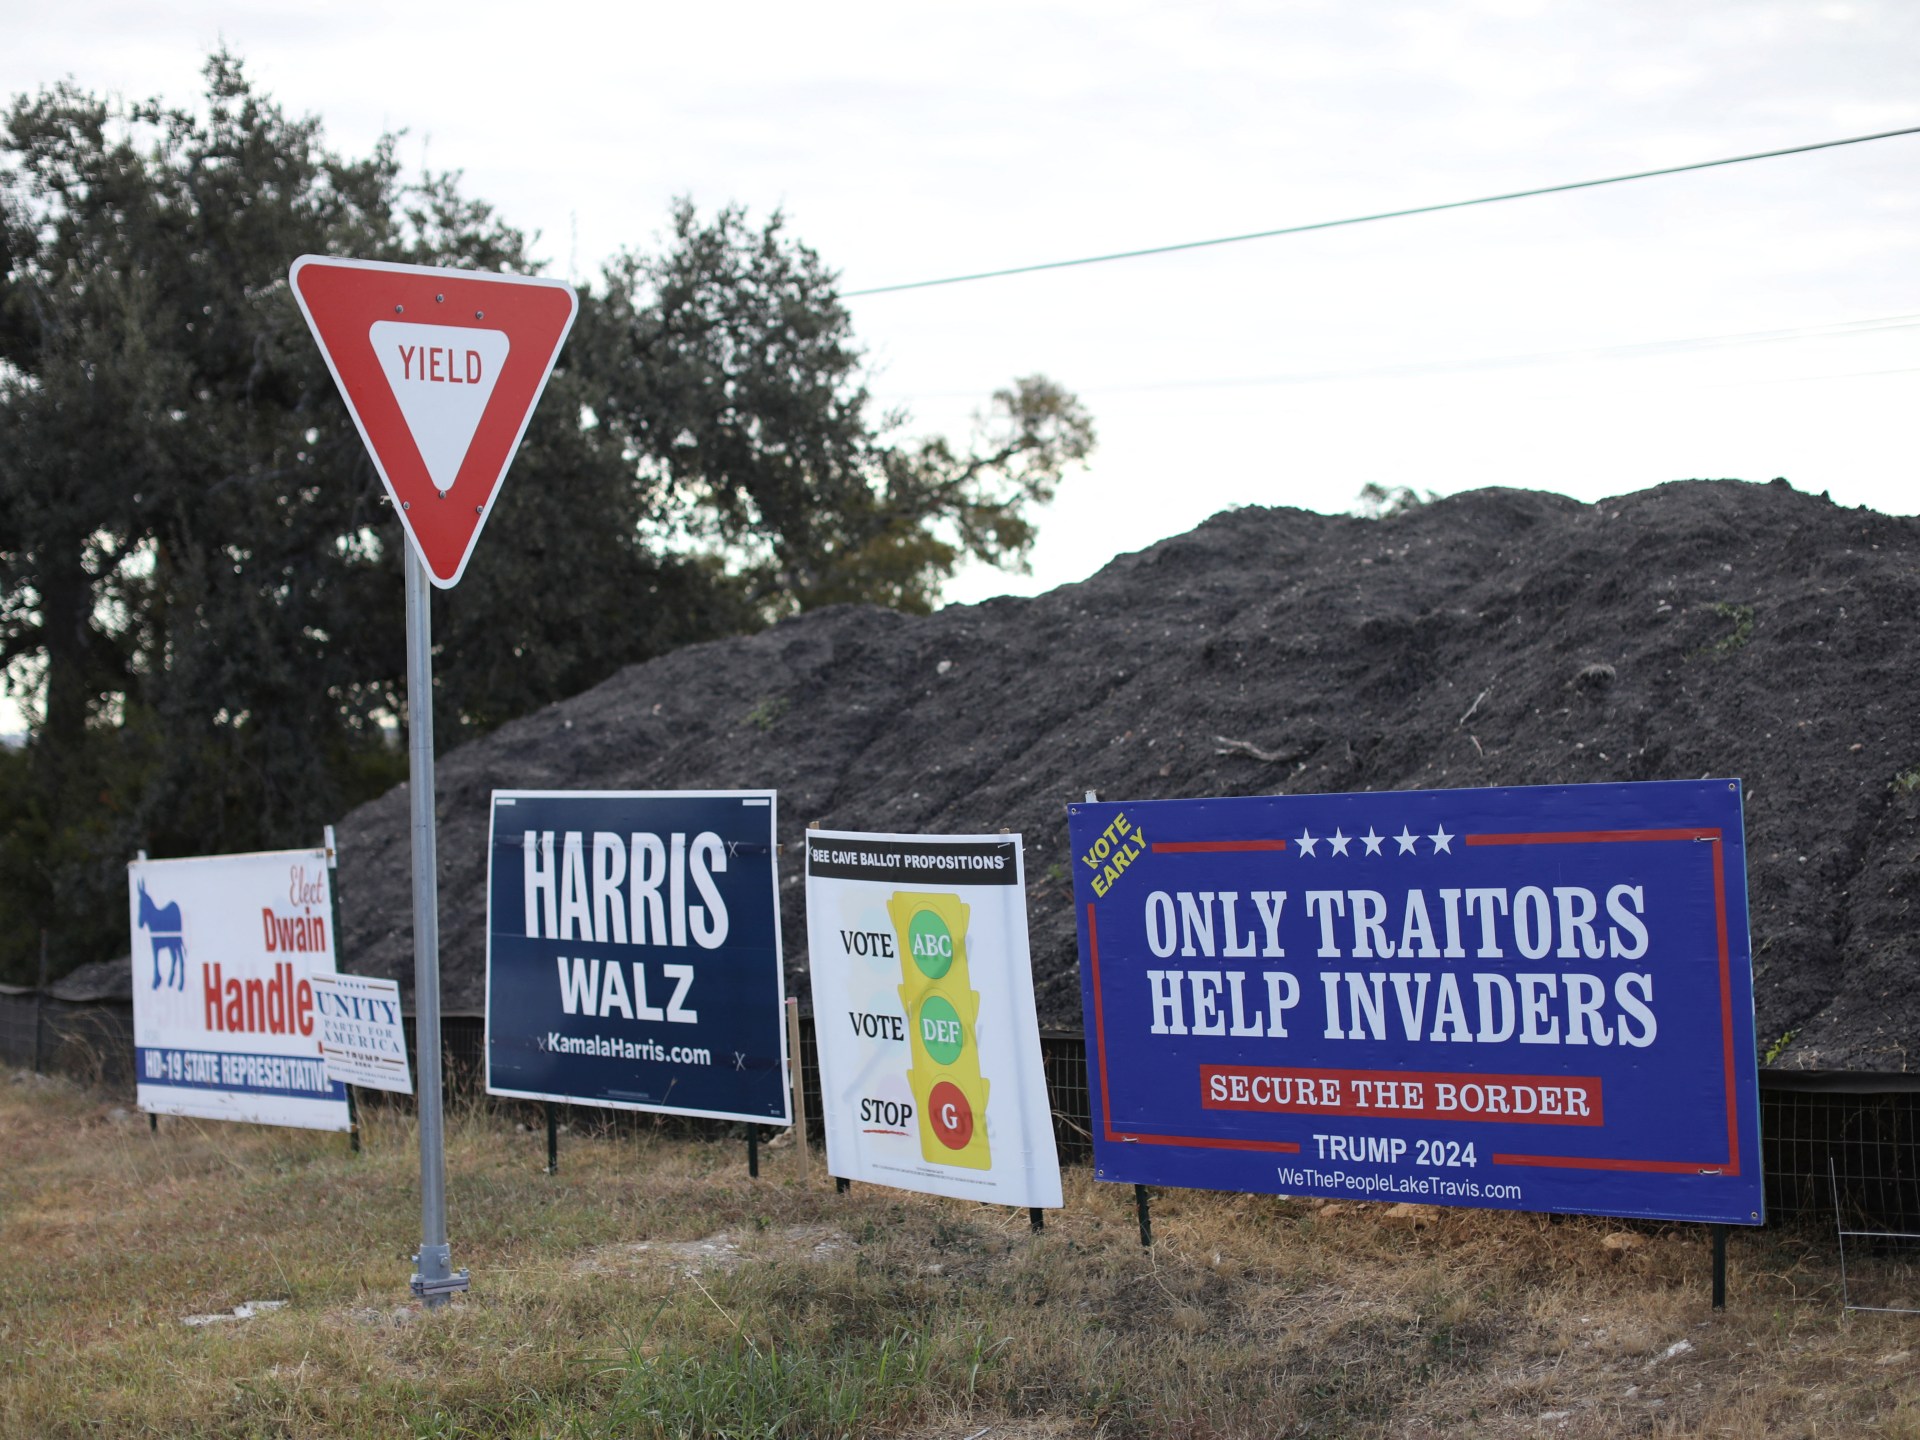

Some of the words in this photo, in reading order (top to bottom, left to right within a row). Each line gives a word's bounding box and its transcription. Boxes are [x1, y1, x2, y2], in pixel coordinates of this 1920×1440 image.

[398, 345, 482, 384] YIELD
[1082, 812, 1132, 870] VOTE
[813, 849, 830, 863] BEE
[831, 850, 858, 865] CAVE
[860, 852, 901, 868] BALLOT
[904, 854, 1005, 870] PROPOSITIONS
[1090, 826, 1147, 898] EARLY
[289, 865, 324, 907] Elect
[524, 830, 729, 950] HARRIS
[262, 907, 326, 952] Dwain
[1145, 890, 1287, 958] ONLY
[1306, 883, 1649, 960] TRAITORS
[840, 930, 894, 958] VOTE
[913, 933, 952, 957] ABC
[557, 956, 698, 1024] WALZ
[203, 962, 323, 1054] Handle
[315, 991, 397, 1026] UNITY
[1147, 970, 1300, 1038] HELP
[1320, 971, 1657, 1048] INVADERS
[324, 1019, 361, 1034] PARTY
[368, 1026, 393, 1039] FOR
[324, 1031, 400, 1054] AMERICA
[849, 1011, 904, 1041] VOTE
[923, 1018, 960, 1043] DEF
[145, 1049, 182, 1081] HD-19
[184, 1051, 220, 1084] STATE
[345, 1050, 380, 1062] TRUMP
[548, 1032, 711, 1066] KamalaHarris.com
[1210, 1074, 1341, 1107] SECURE
[1351, 1081, 1424, 1110] THE
[1435, 1083, 1590, 1117] BORDER
[860, 1098, 913, 1128] STOP
[941, 1103, 958, 1130] G
[1313, 1134, 1407, 1163] TRUMP
[1415, 1139, 1477, 1168] 2024
[1277, 1167, 1522, 1200] WeThePeopleLakeTravis.com
